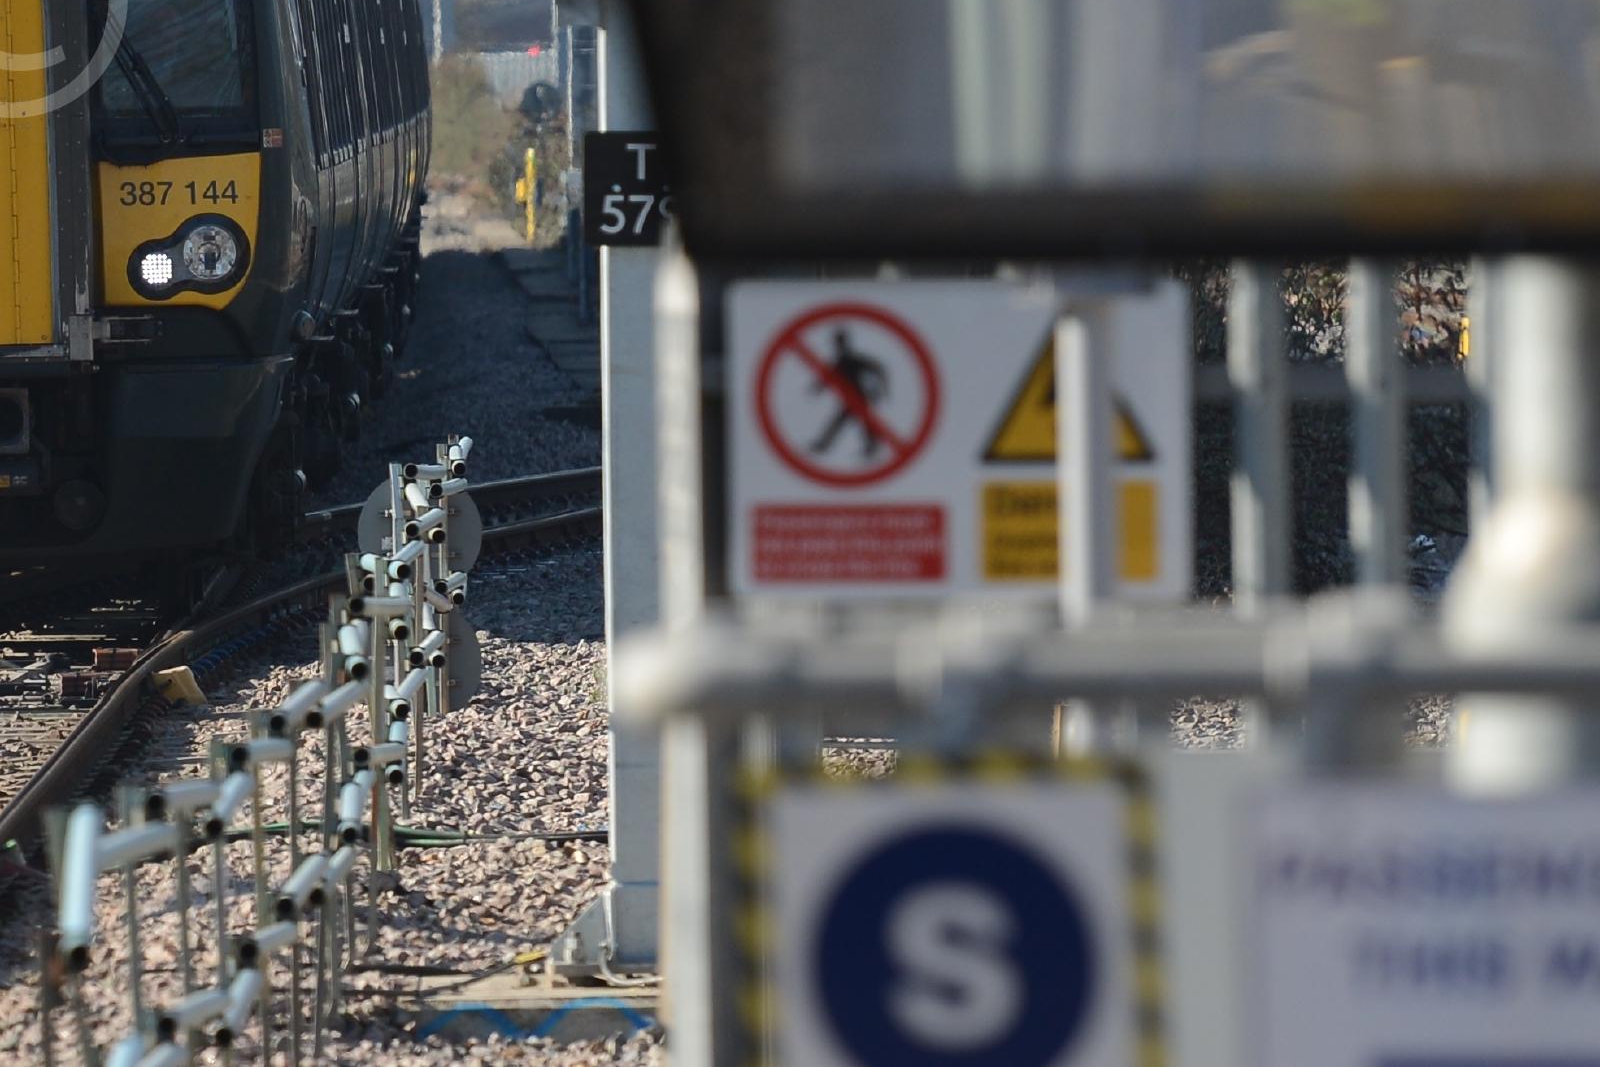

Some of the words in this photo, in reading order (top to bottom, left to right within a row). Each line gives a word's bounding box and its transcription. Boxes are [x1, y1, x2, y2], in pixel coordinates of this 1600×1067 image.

[626, 143, 657, 180] T
[119, 181, 173, 206] 387
[184, 179, 239, 205] 144
[885, 879, 1028, 1052] S
